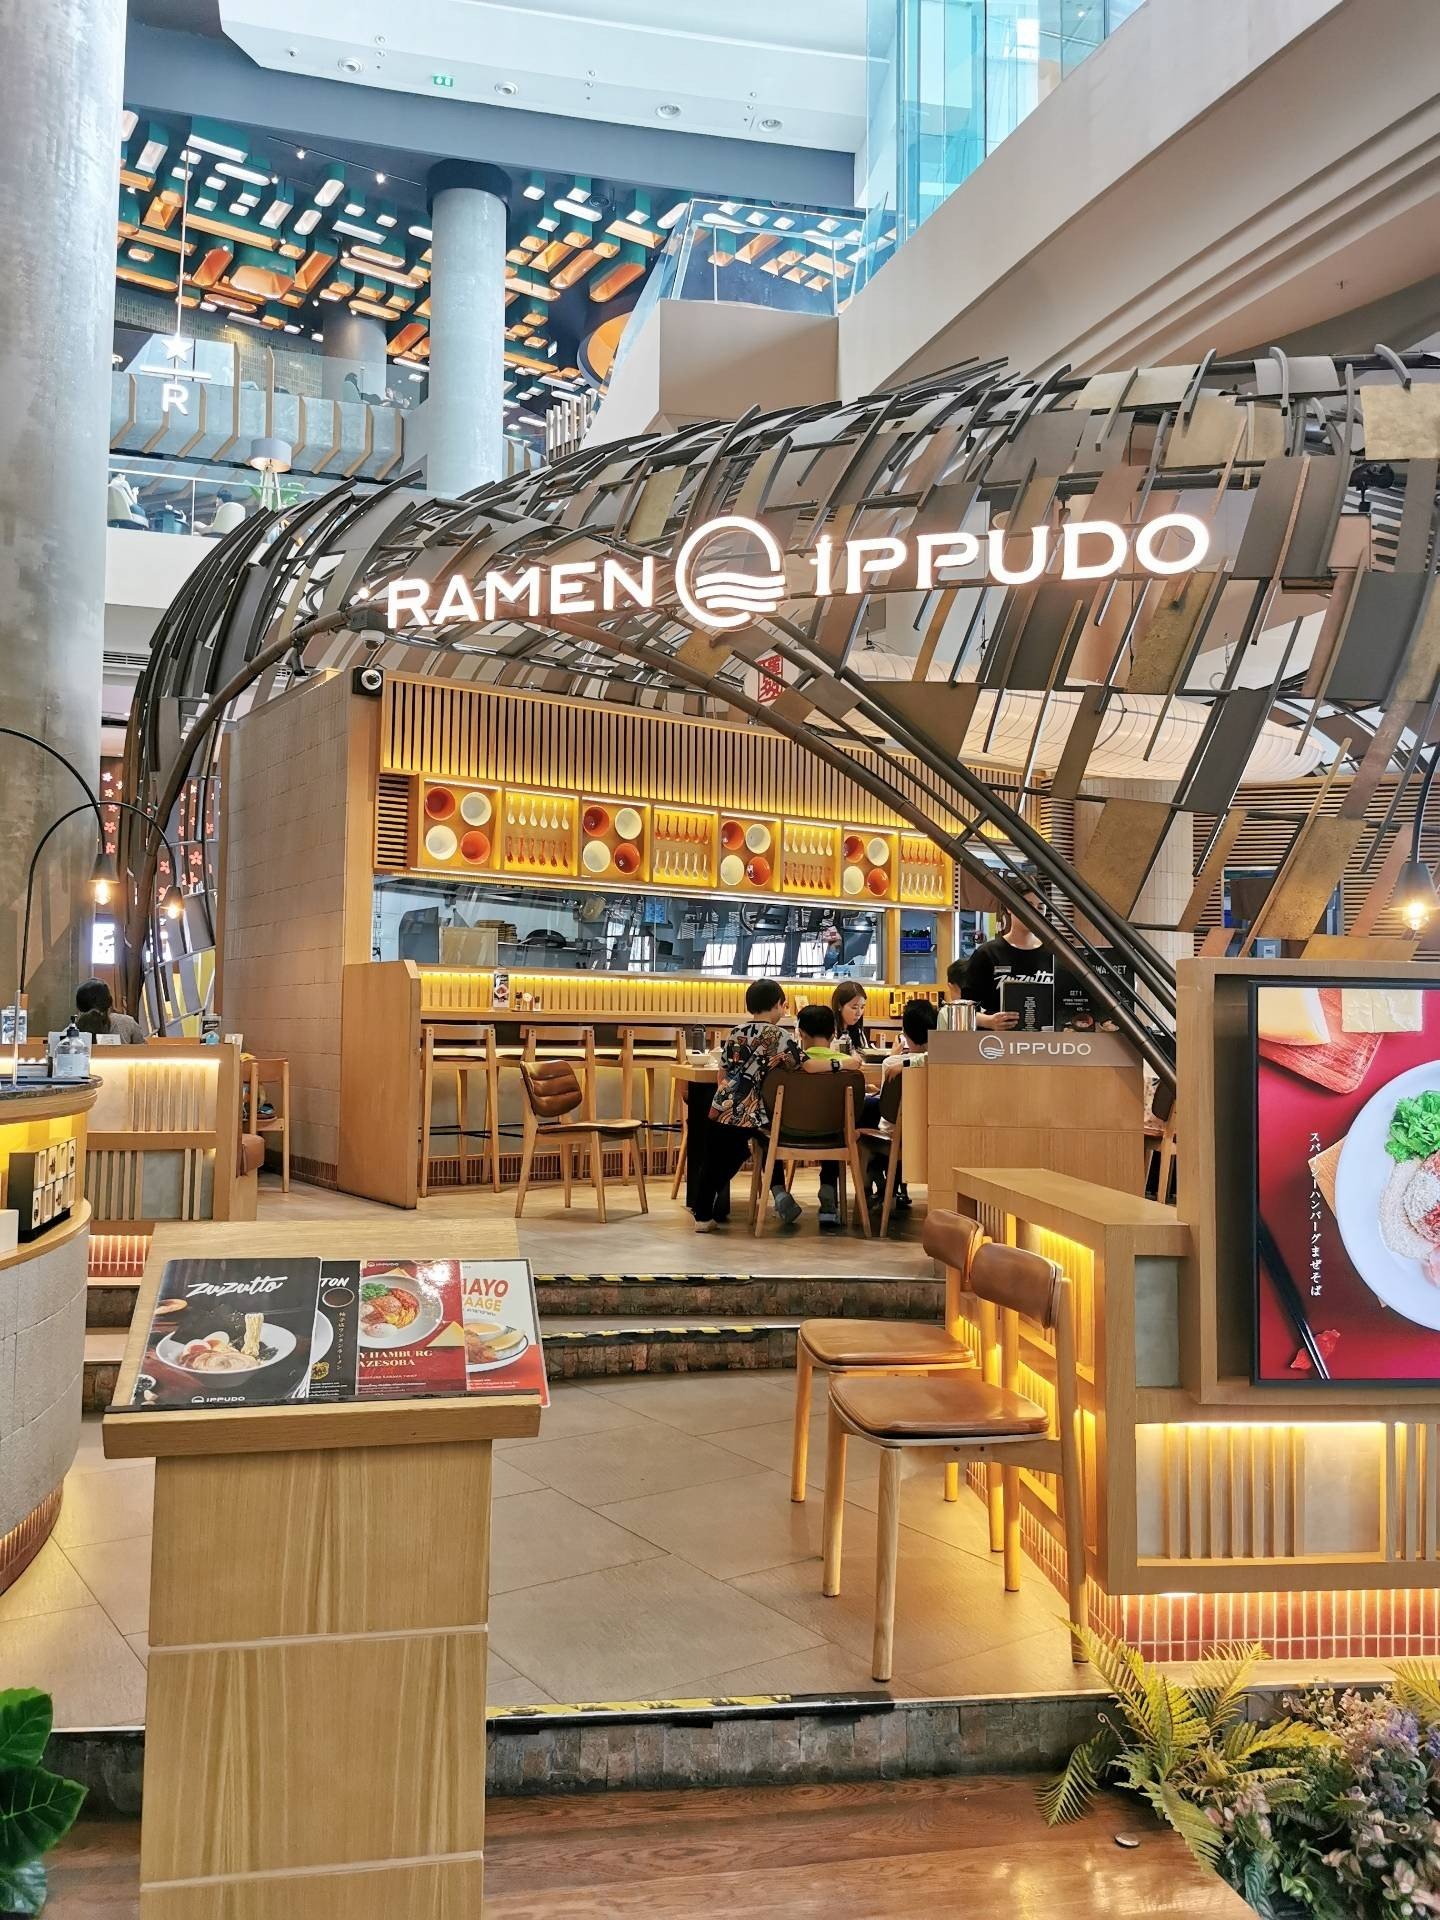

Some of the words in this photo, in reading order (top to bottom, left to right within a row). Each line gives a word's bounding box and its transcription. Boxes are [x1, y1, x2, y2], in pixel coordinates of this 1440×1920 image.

[162, 383, 189, 416] R
[386, 555, 655, 630] RAMEN
[1009, 1042, 1092, 1056] IPPUDO
[369, 1350, 433, 1359] HAMBURG
